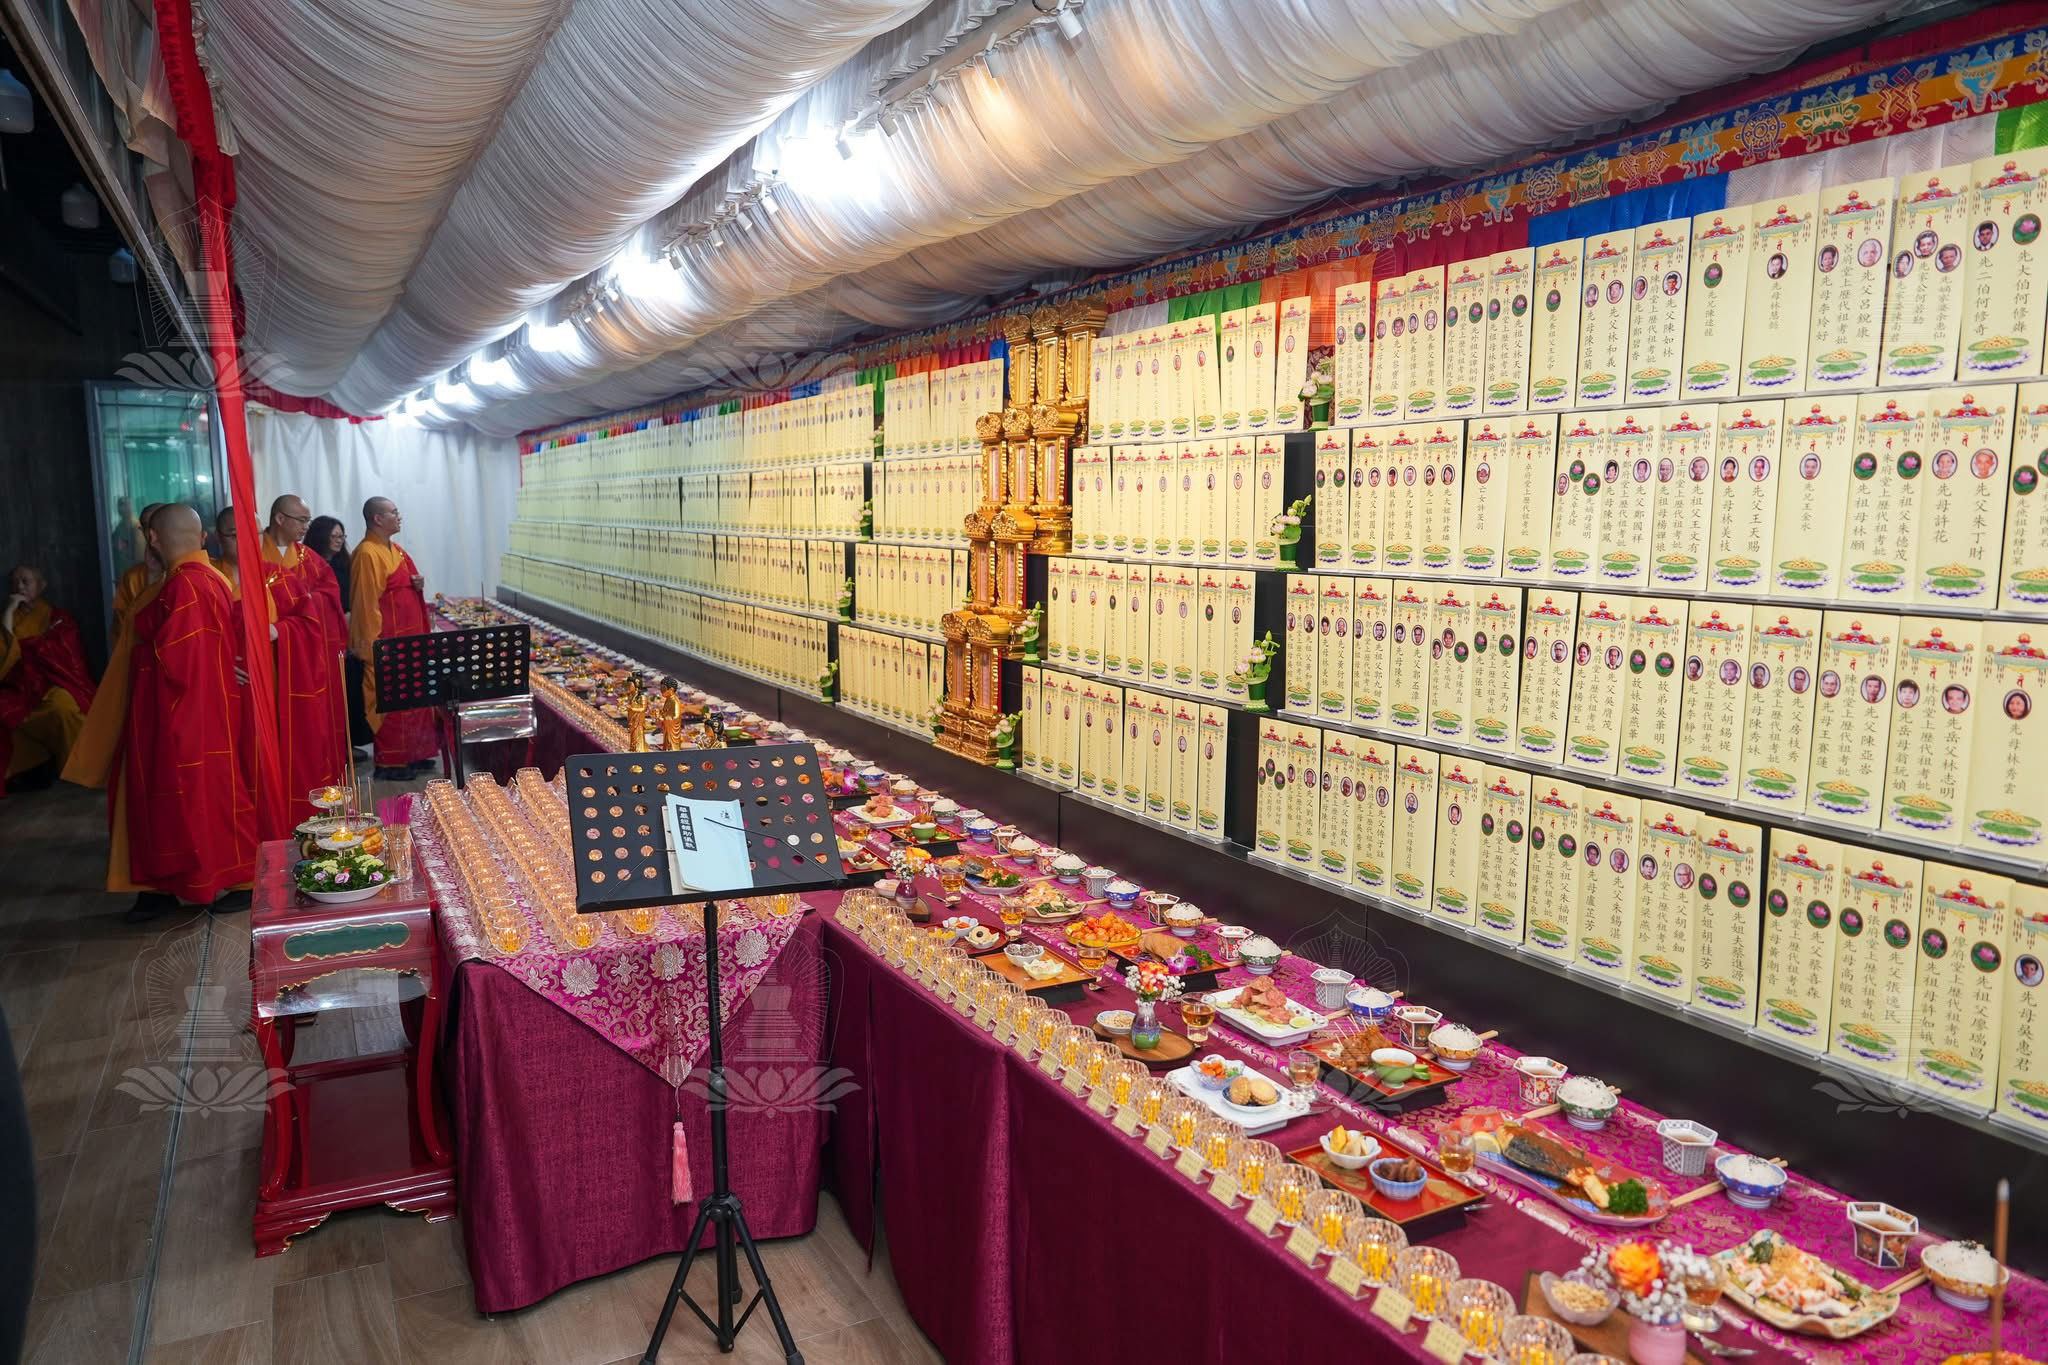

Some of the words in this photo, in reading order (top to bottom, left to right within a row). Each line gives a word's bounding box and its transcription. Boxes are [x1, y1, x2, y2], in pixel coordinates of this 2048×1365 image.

[1607, 307, 1619, 368] 先父林和義
[1663, 298, 1675, 358] 先父陳如林
[1747, 485, 1763, 553] 先父王天賜
[1934, 483, 1952, 544] 先母許花
[1969, 484, 1988, 560] 先父朱丁財
[1500, 659, 1511, 713] 先父王馬力
[1940, 718, 1958, 799] 先岳父林志明
